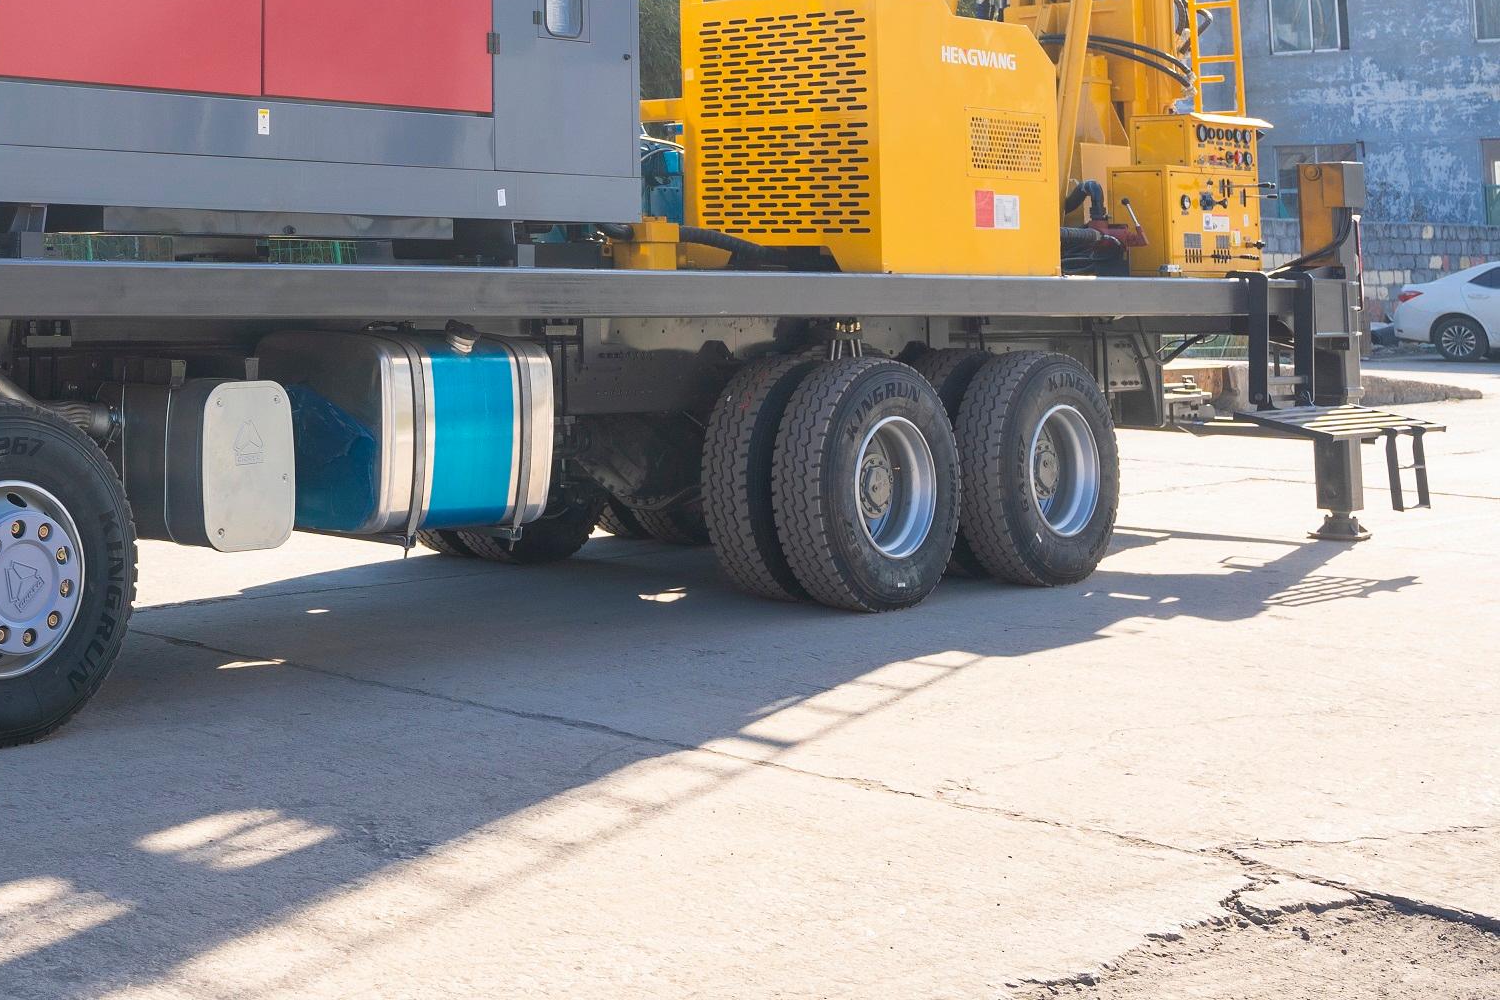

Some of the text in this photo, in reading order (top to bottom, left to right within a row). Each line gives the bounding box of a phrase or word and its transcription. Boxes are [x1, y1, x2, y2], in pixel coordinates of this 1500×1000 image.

[941, 45, 1017, 71] HENGWANG
[846, 383, 921, 442] KINGRUN
[67, 510, 125, 693] KINGRUN
